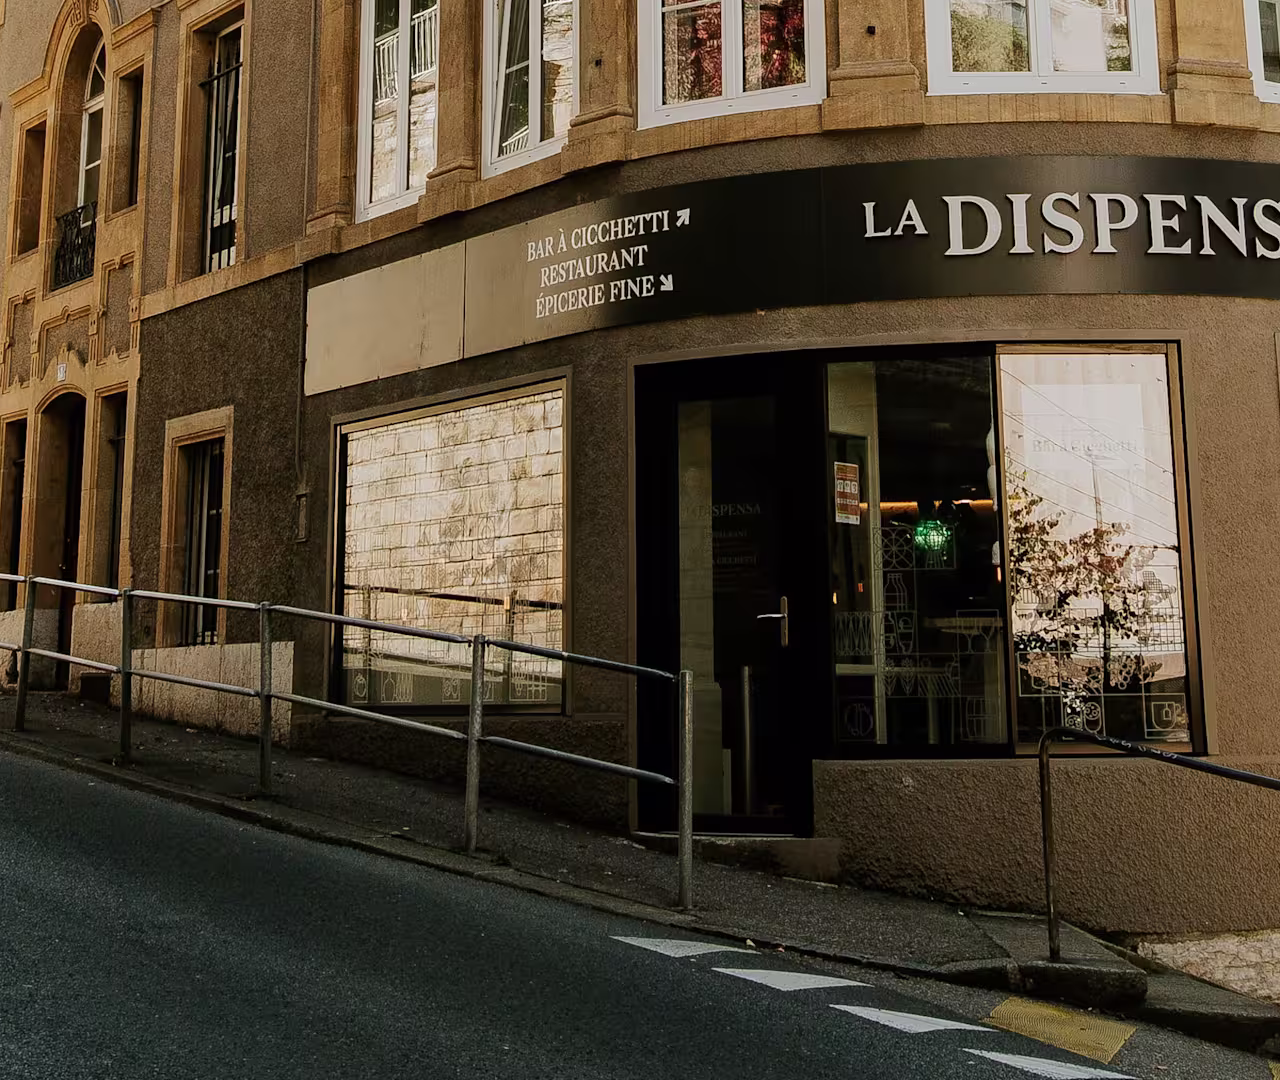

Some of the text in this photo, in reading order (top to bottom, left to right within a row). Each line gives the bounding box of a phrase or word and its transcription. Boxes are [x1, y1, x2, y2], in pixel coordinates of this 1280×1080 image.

[527, 210, 670, 262] BAR À CICCHETTI
[862, 199, 929, 238] LA
[539, 244, 648, 287] RESTAURANT
[535, 275, 655, 318] ÉPICERIE FINE
